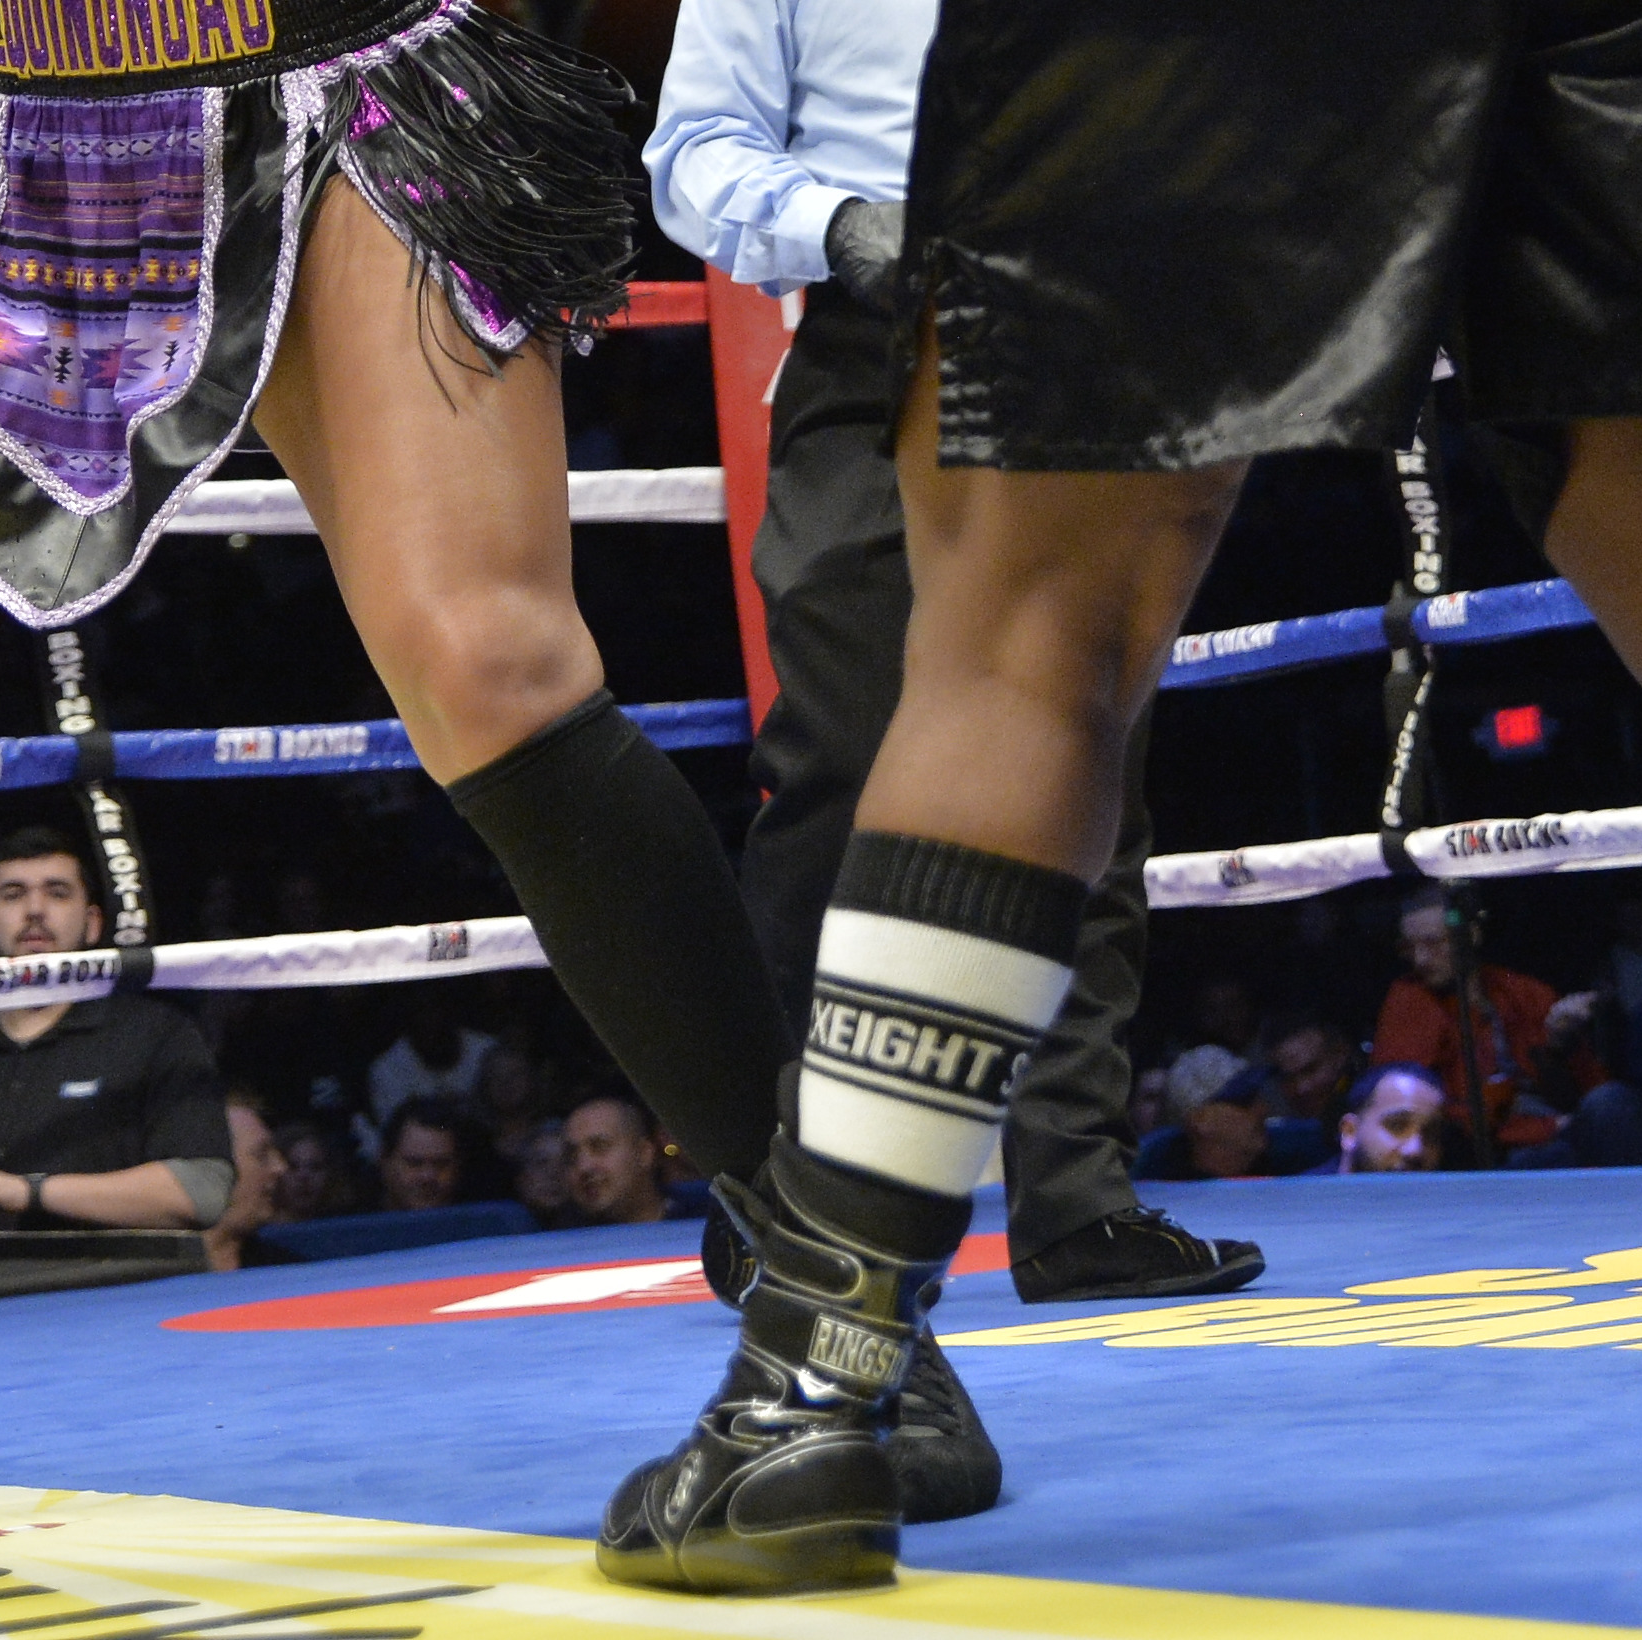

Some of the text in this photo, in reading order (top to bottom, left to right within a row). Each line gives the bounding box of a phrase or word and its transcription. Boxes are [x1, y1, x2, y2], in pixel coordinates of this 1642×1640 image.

[1401, 480, 1443, 594] BOXING
[47, 630, 96, 736] BOXING
[103, 838, 147, 946] BOXING
